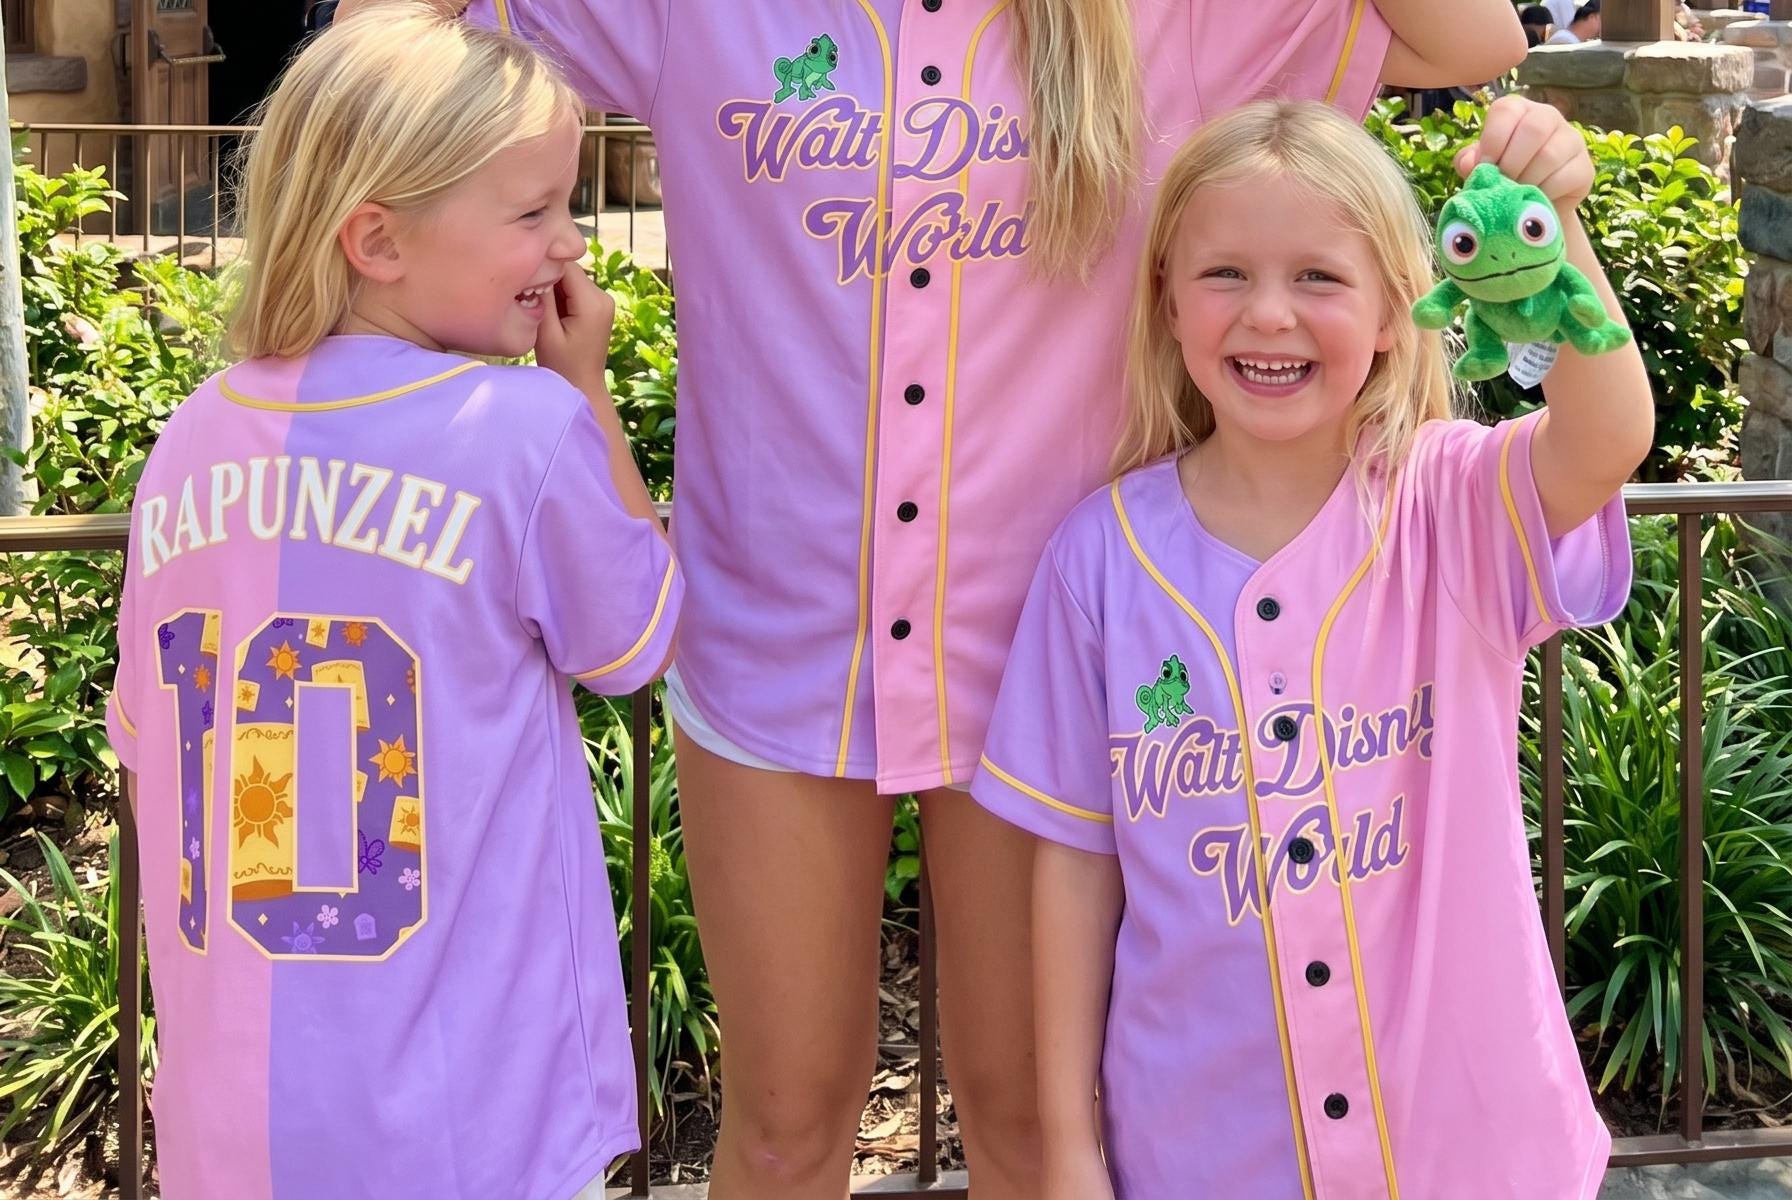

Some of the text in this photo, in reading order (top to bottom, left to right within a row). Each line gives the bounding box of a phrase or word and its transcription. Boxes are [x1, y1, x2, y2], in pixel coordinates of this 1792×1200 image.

[716, 95, 1032, 183] Walt Dis
[139, 455, 482, 585] RAPUNZEL
[154, 607, 428, 962] 10
[1110, 717, 1246, 823] Walt
